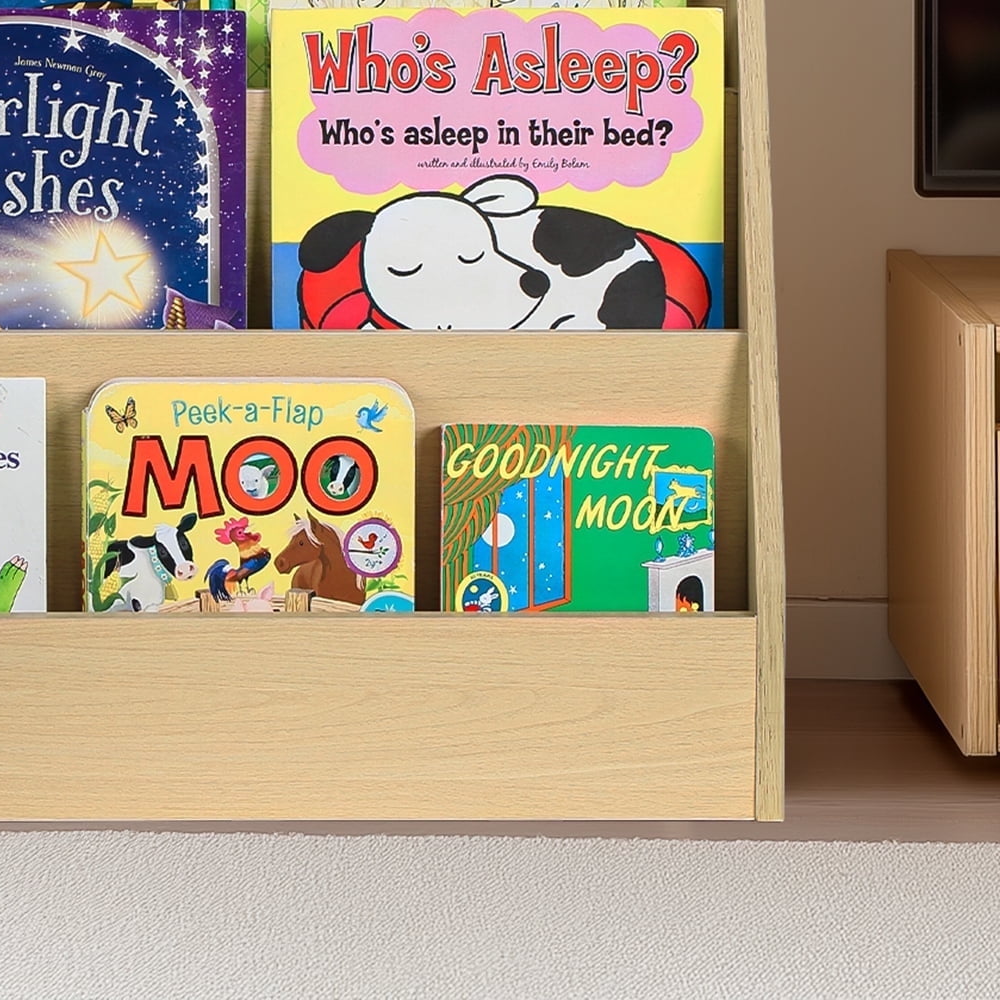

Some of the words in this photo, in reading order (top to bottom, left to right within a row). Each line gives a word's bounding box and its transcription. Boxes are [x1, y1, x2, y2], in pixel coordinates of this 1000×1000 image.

[14, 56, 42, 67] James
[44, 57, 83, 73] Newman
[84, 64, 107, 81] Gray
[302, 22, 457, 95] Who's
[472, 22, 699, 116] Asleep?
[319, 118, 395, 146] Who's
[403, 117, 489, 154] asleep
[498, 119, 520, 146] in
[528, 117, 594, 146] their
[602, 117, 674, 146] bed?
[417, 157, 449, 168] written
[450, 157, 469, 168] and
[469, 157, 517, 168] illustrated
[518, 157, 530, 172] by
[532, 157, 559, 172] Emily
[561, 158, 591, 169] Bolam
[171, 395, 324, 431] Peek-a-Flap
[122, 434, 379, 518] MOO
[446, 443, 669, 479] GOODNIGHT
[575, 494, 690, 531] MOON
